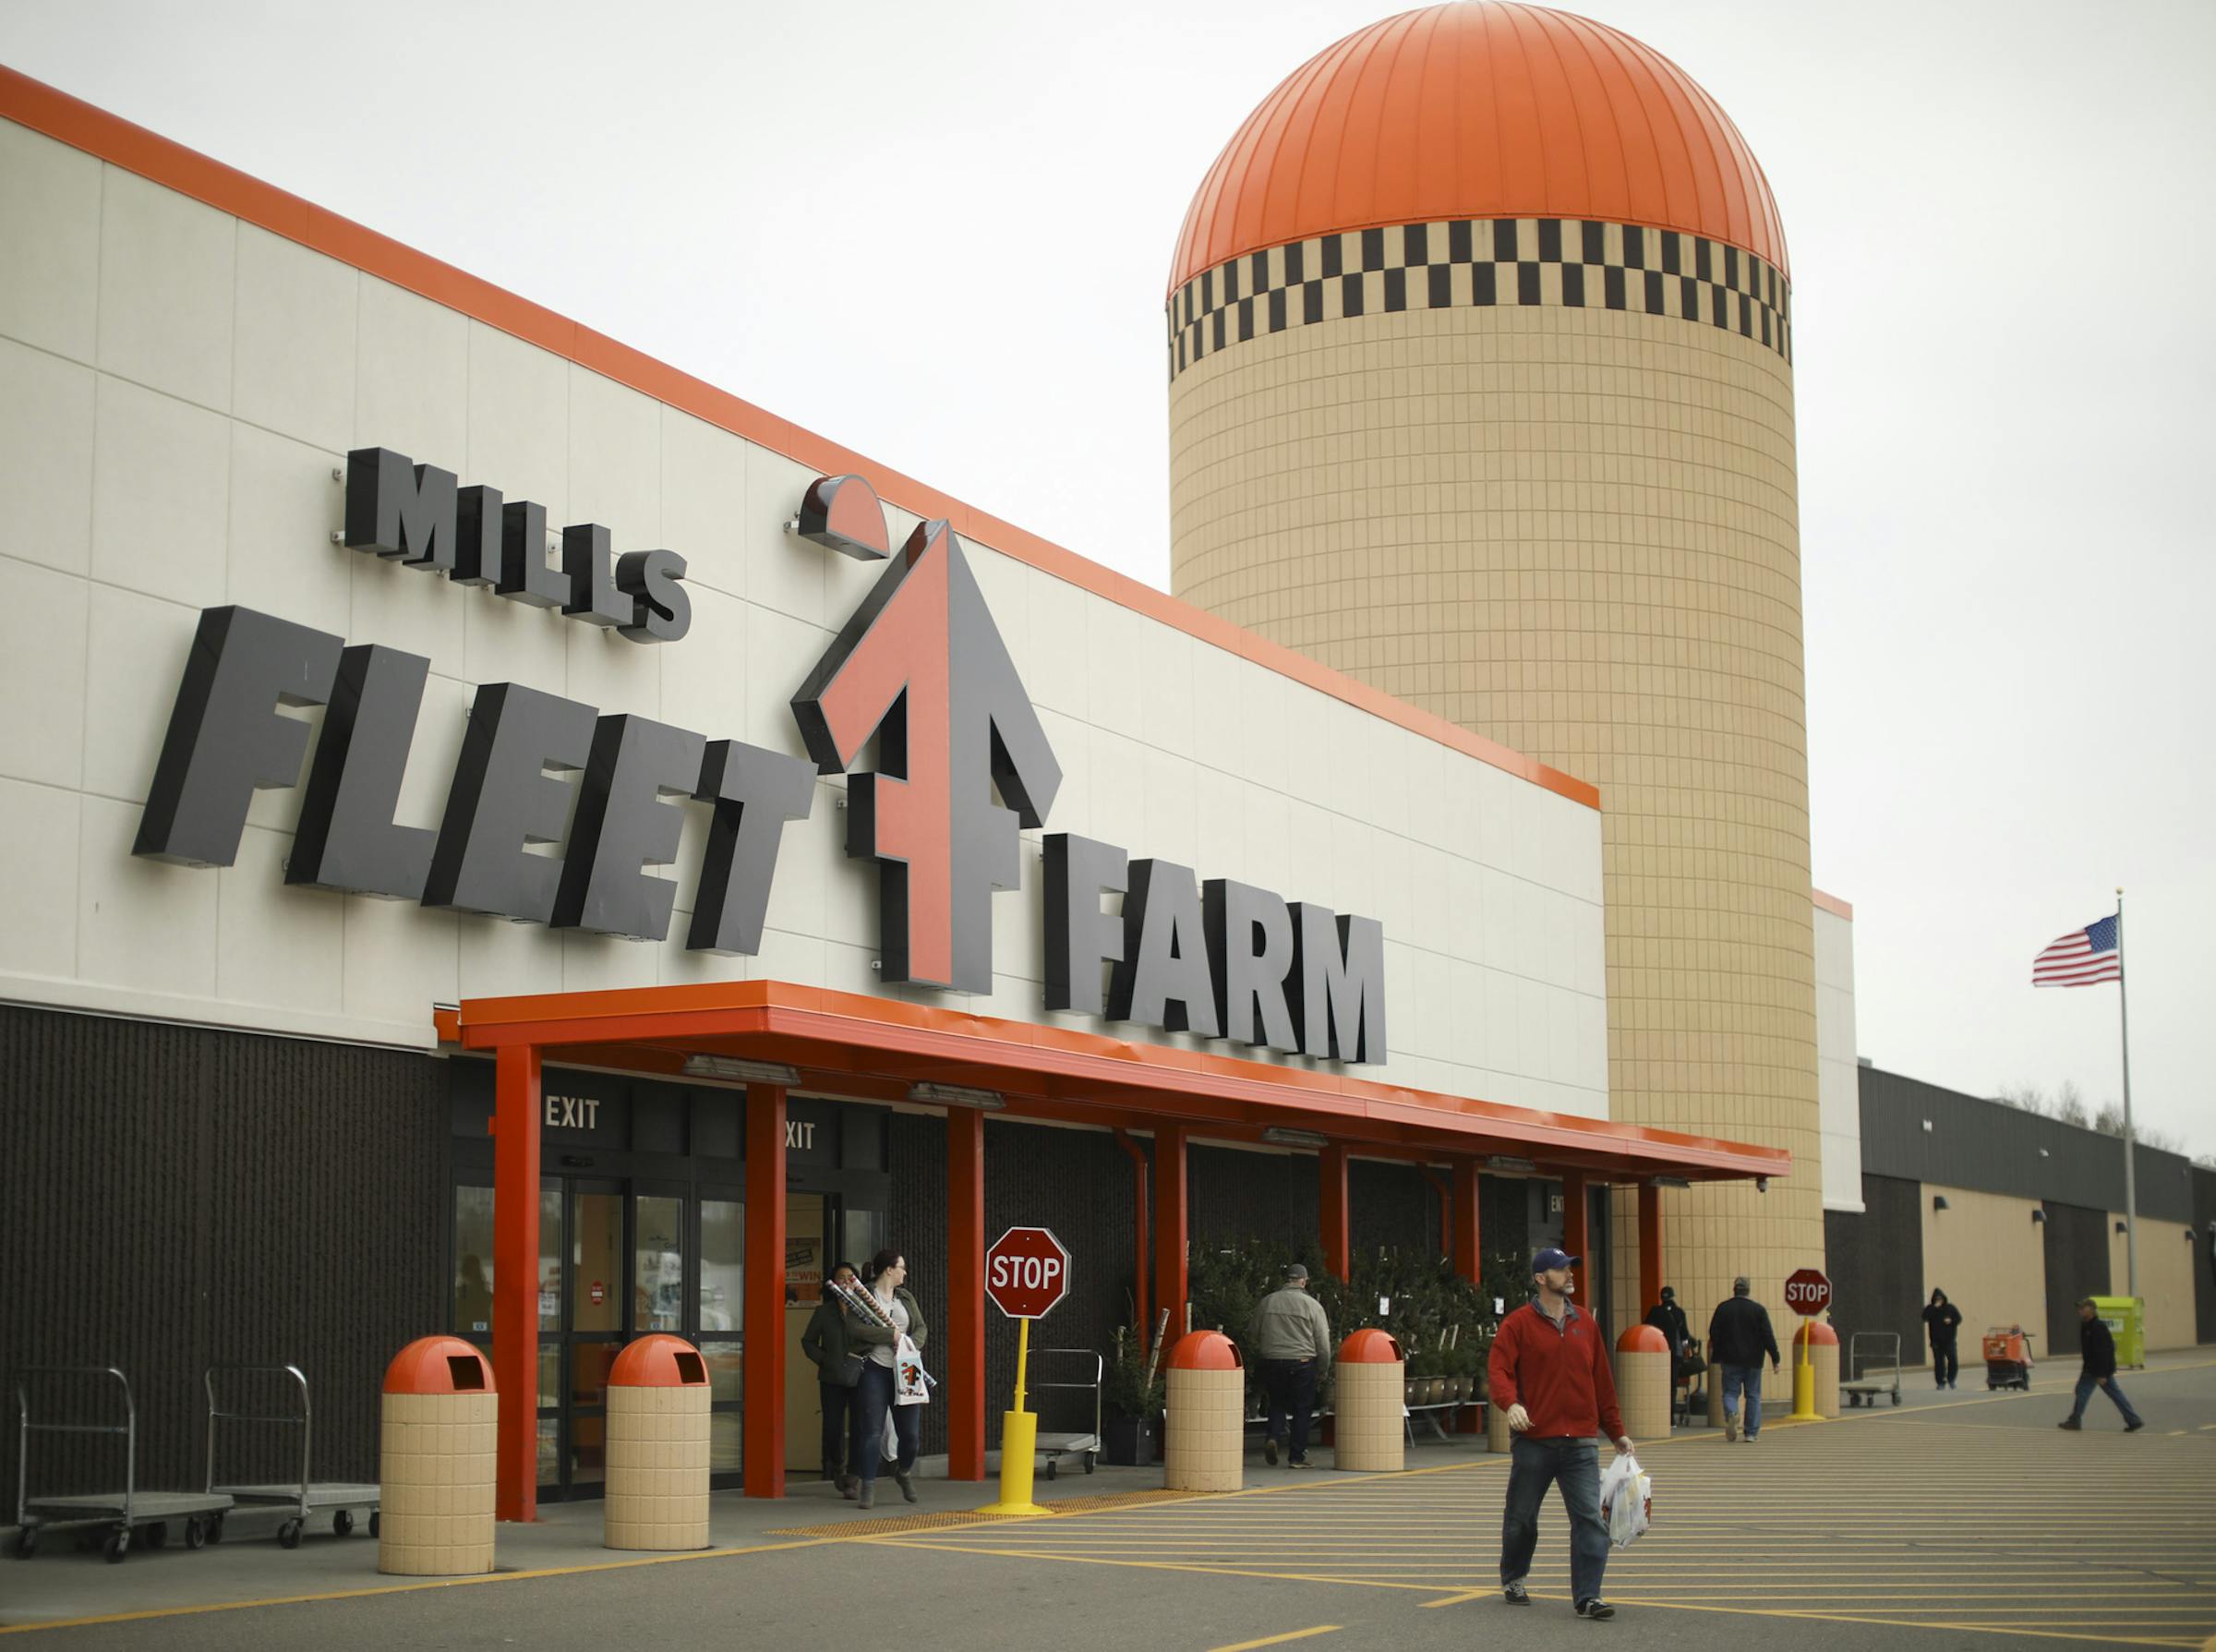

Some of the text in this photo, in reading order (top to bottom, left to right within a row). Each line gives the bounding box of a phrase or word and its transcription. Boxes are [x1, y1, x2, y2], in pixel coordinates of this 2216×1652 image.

[345, 447, 690, 645] MILLS
[131, 606, 1388, 1067] FLEET FARM
[545, 1095, 599, 1129] EXIT
[785, 1121, 815, 1150] XIT
[992, 1255, 1061, 1289] STOP
[1787, 1282, 1828, 1302] STOP
